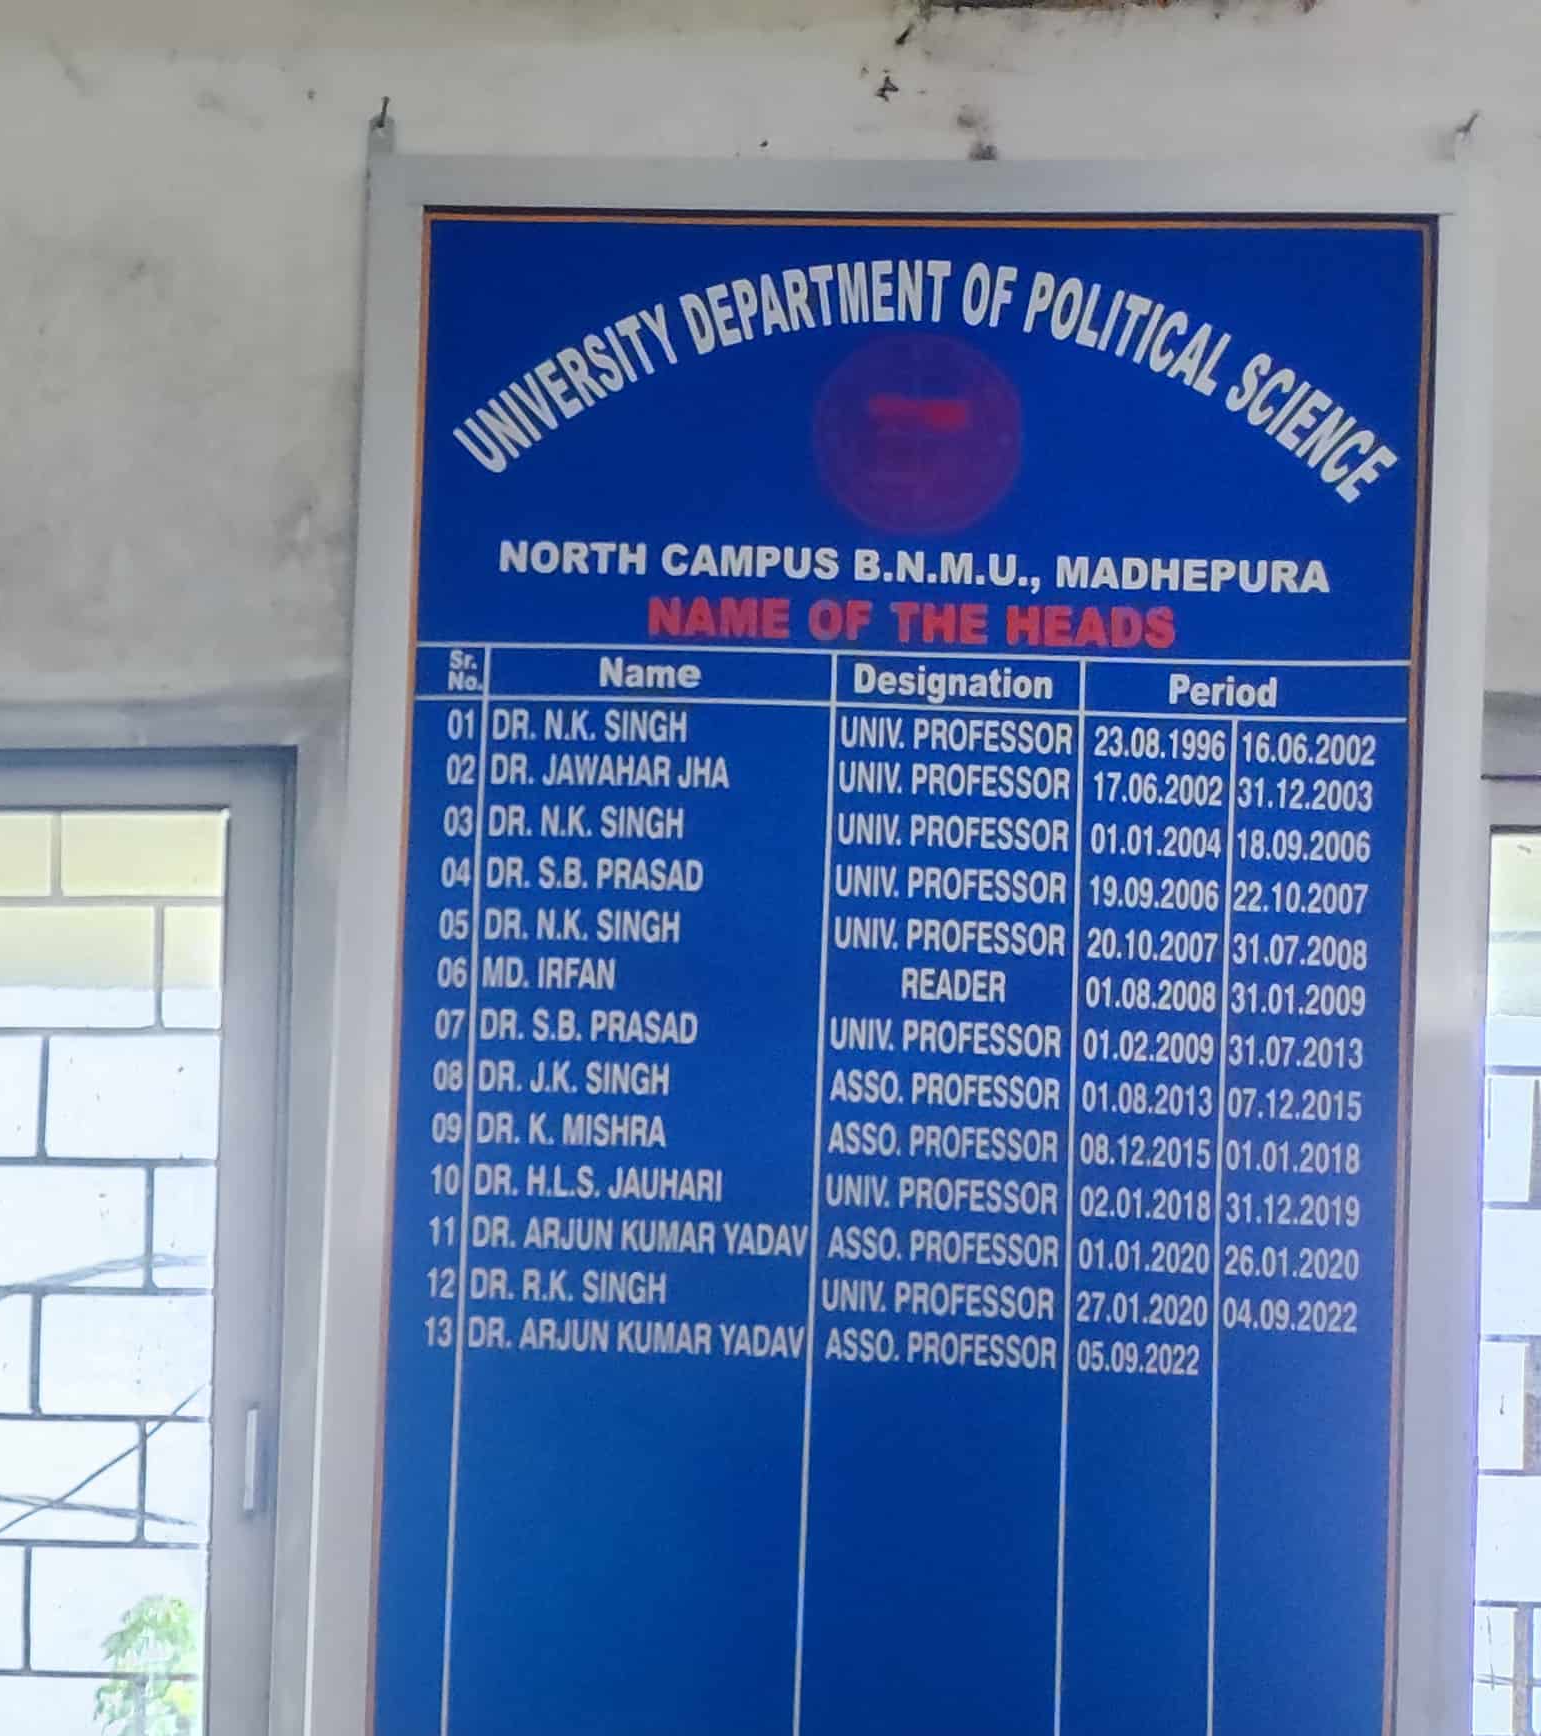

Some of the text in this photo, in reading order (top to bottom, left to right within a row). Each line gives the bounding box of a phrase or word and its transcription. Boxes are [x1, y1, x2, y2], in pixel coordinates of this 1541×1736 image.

[452, 259, 1398, 505] UNIVERSITY DEPARTMENT OF POLITICAL SCIENCE
[500, 541, 1329, 594] NORTH CAMPUS B.N.M.U., MADHEPURA
[649, 597, 1175, 648] NAME OF THE HEADS
[450, 649, 477, 669] Sr.
[600, 657, 701, 688] Name
[448, 672, 482, 692] No.
[854, 663, 1053, 702] Designation
[1169, 674, 1277, 707] Period
[448, 709, 687, 742] 01 DR. N.K. SINGH
[841, 716, 1072, 754] UNIV. PROFESSOR
[1094, 726, 1225, 761] 23.08.1996
[1243, 732, 1376, 765] 16.06.2002
[447, 753, 729, 788] 02 DR. JAWAHAR JHA
[840, 761, 1070, 800] UNIV. PROFESSOR
[1094, 771, 1223, 806] 17.06.2002
[1237, 777, 1372, 812] 31.12.2003
[444, 805, 683, 839] 03 DR. N.K. SINGH
[838, 813, 1069, 851] UNIV. PROFESSOR
[1091, 823, 1221, 858] 01.01.2004
[1237, 829, 1370, 862] 18.09.2006
[442, 856, 703, 891] 04 DR. S.B. PRASAD
[836, 864, 1066, 904] UNIV. PROFESSOR
[1091, 876, 1219, 911] 19.09.2006
[1233, 881, 1368, 914] 22.10.2007
[440, 908, 680, 943] 05 DR. N.K. SINGH
[835, 917, 1065, 956] UNIV. PROFESSOR
[1088, 928, 1218, 962] 20.10.2007
[1233, 933, 1367, 970] 31.07.2008
[438, 956, 615, 989] 06 MD. IRFAN
[902, 968, 1005, 1002] READER
[1086, 976, 1216, 1012] 01.08.2008
[1231, 982, 1365, 1016] 31.01.2009
[435, 1008, 698, 1044] 07 DR. S.B. PRASAD
[831, 1017, 1061, 1057] UNIV. PROFESSOR
[1084, 1029, 1214, 1064] 01.02.2009
[1229, 1034, 1363, 1069] 31.07.2013
[434, 1060, 669, 1095] 08 DR. J.K. SINGH
[830, 1070, 1060, 1109] ASSO. PROFESSOR
[1082, 1081, 1212, 1117] 01.08.2013
[1228, 1088, 1361, 1121] 07.12.2015
[433, 1112, 665, 1147] 09 DR. K. MISHRA
[828, 1122, 1057, 1162] ASSO. PROFESSOR
[1080, 1133, 1210, 1168] 08.12.2015
[1226, 1140, 1360, 1174] 01.01.2018
[432, 1164, 722, 1201] 10 DR. H.L.S. JAUHARI
[826, 1174, 1057, 1215] UNIV. PROFESSOR
[1080, 1186, 1210, 1221] 02.01.2018
[1226, 1192, 1360, 1227] 31.12.2019
[429, 1216, 808, 1256] 11 DR. ARJUN KUMAR YADAV
[828, 1226, 1059, 1267] ASSO. PROFESSOR
[1079, 1238, 1210, 1274] 01.01.2020
[1225, 1245, 1359, 1280] 26.01.2020
[428, 1268, 666, 1304] 12 DR. R.K. SINGH
[822, 1279, 1054, 1320] UNIV. PROFESSOR
[1077, 1291, 1208, 1327] 27.01.2020
[1223, 1297, 1357, 1333] 04.09.2022
[425, 1316, 805, 1358] 13 DR. ARJUN KUMAR YADAV
[826, 1328, 1056, 1368] ASSO. PROFESSOR
[1077, 1340, 1199, 1375] 05.09.2022
